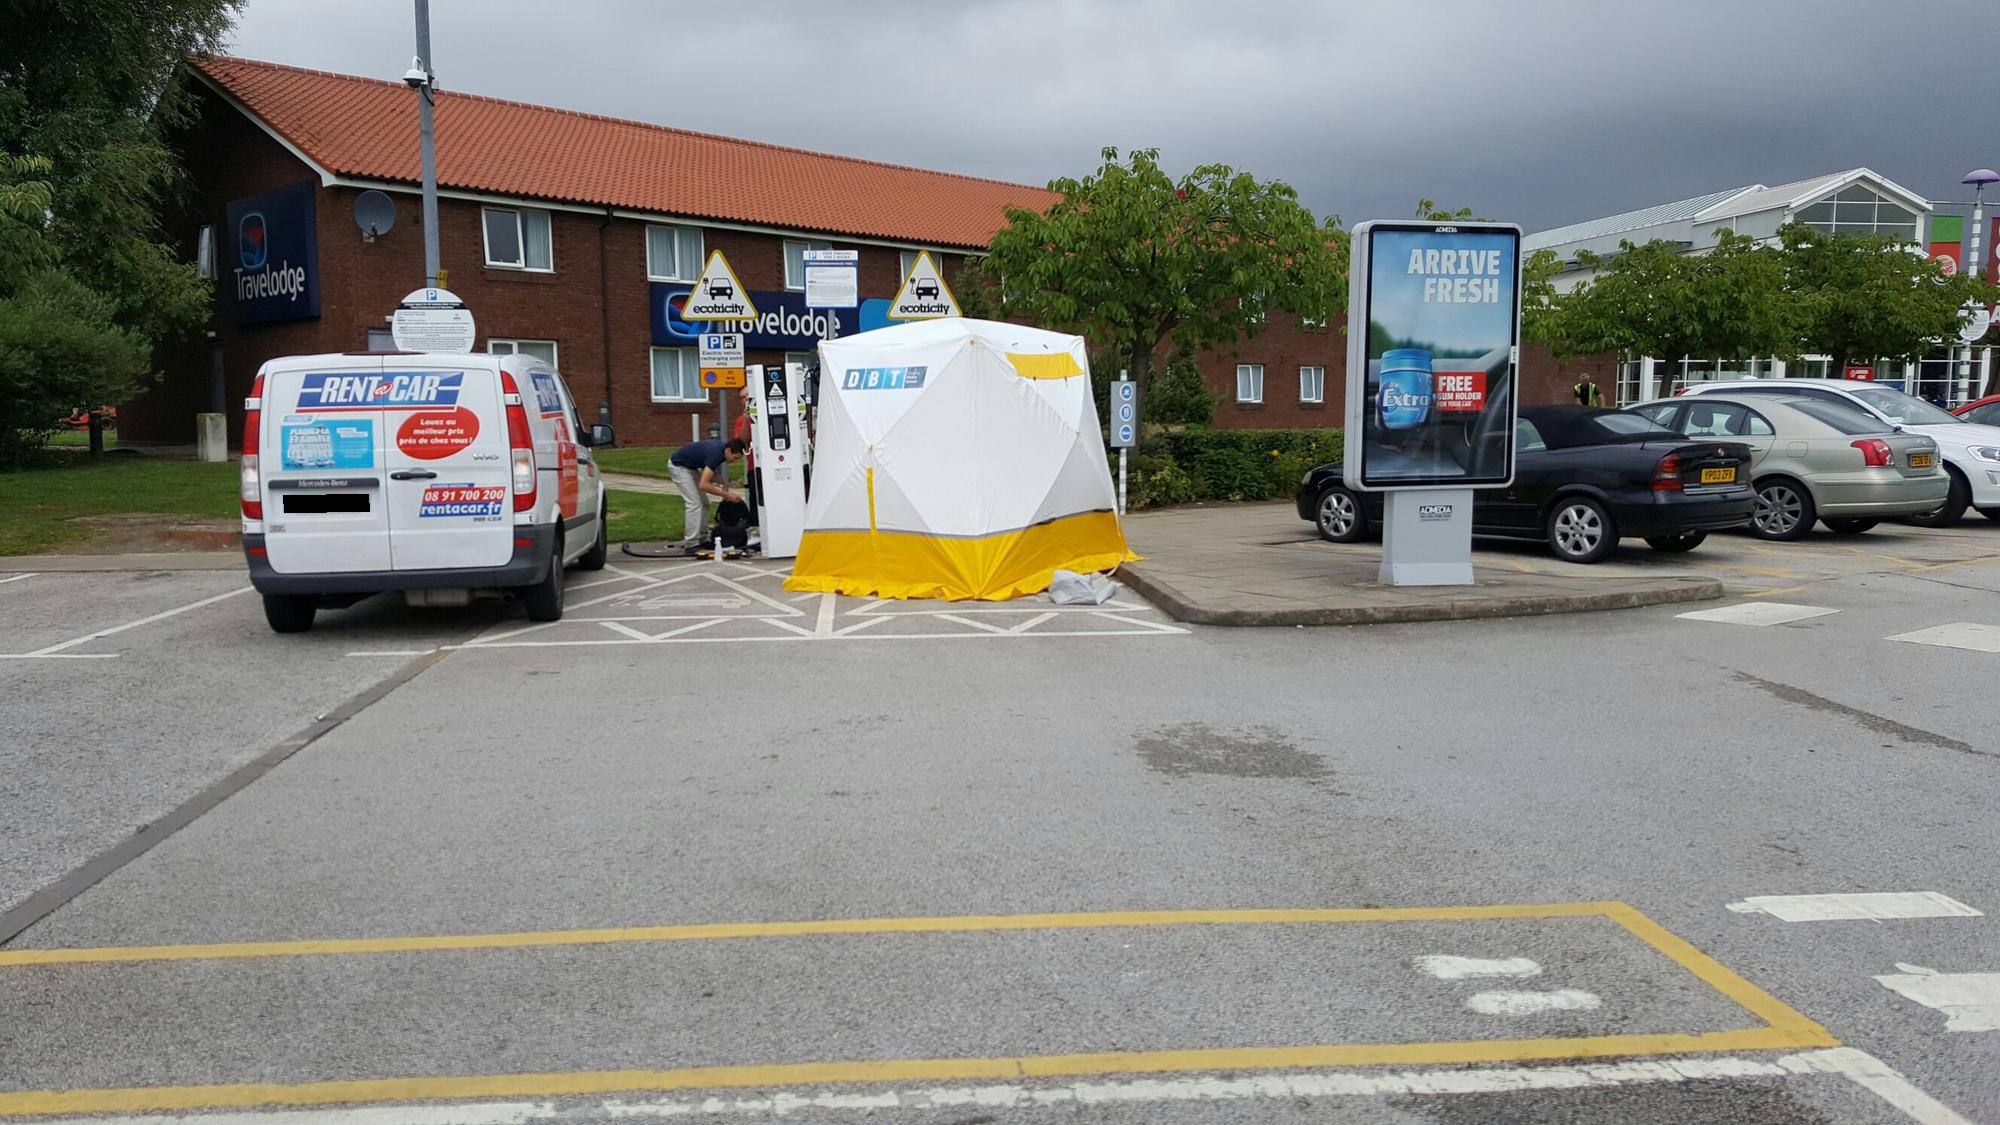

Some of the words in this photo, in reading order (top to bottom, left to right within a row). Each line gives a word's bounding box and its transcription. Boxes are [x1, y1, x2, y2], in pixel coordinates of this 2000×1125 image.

[1407, 248, 1501, 275] ARRIVE
[233, 259, 305, 301] Travelodge
[1423, 278, 1499, 304] FRESH
[693, 303, 745, 315] ecotricity
[899, 303, 950, 315] ecotricity
[710, 336, 720, 348] P
[319, 376, 383, 403] RENT
[388, 375, 442, 401] CAR
[1437, 375, 1474, 392] FREE
[1382, 388, 1430, 407] Extra
[1437, 392, 1454, 400] GUM
[1455, 392, 1482, 400] HOLDER
[420, 418, 444, 426] Louez
[413, 427, 446, 435] meilleur
[447, 427, 465, 436] prix
[418, 436, 429, 444] de
[429, 436, 449, 444] chez
[298, 479, 348, 488] Mercedes-Benz
[424, 491, 439, 502] 08
[441, 491, 456, 501] 91
[459, 490, 480, 501] 700
[482, 490, 504, 500] 200
[420, 501, 502, 515] rentacar.fr
[1419, 505, 1452, 514] ADMEDIA
